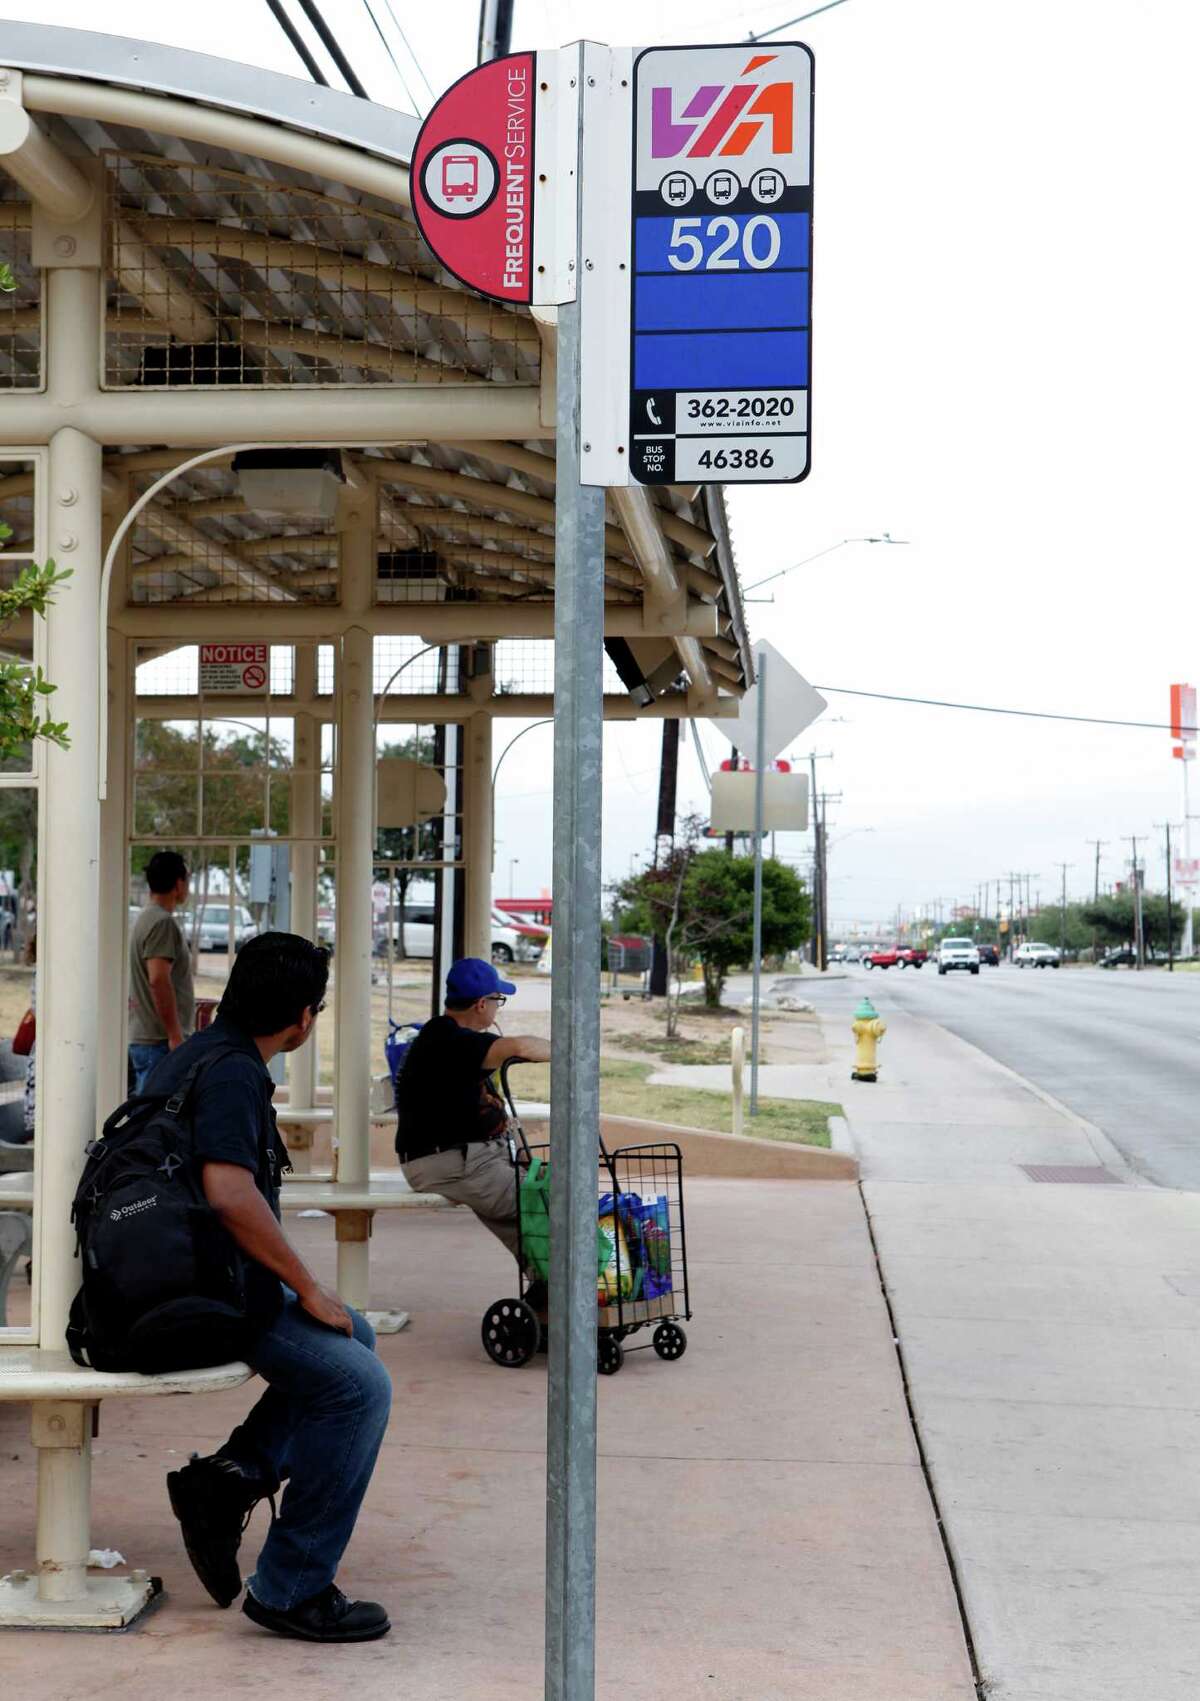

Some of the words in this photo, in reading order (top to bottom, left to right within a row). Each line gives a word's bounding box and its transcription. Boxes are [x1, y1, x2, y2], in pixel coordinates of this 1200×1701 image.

[667, 215, 781, 271] 520
[687, 397, 794, 418] 362-2020
[700, 419, 781, 428] www.viainfo.net
[645, 446, 663, 454] BUS
[642, 455, 666, 463] STOP
[698, 449, 774, 469] 46386
[646, 463, 664, 472] NO.
[202, 647, 265, 662] NOTICE
[121, 1195, 158, 1214] Outdoor
